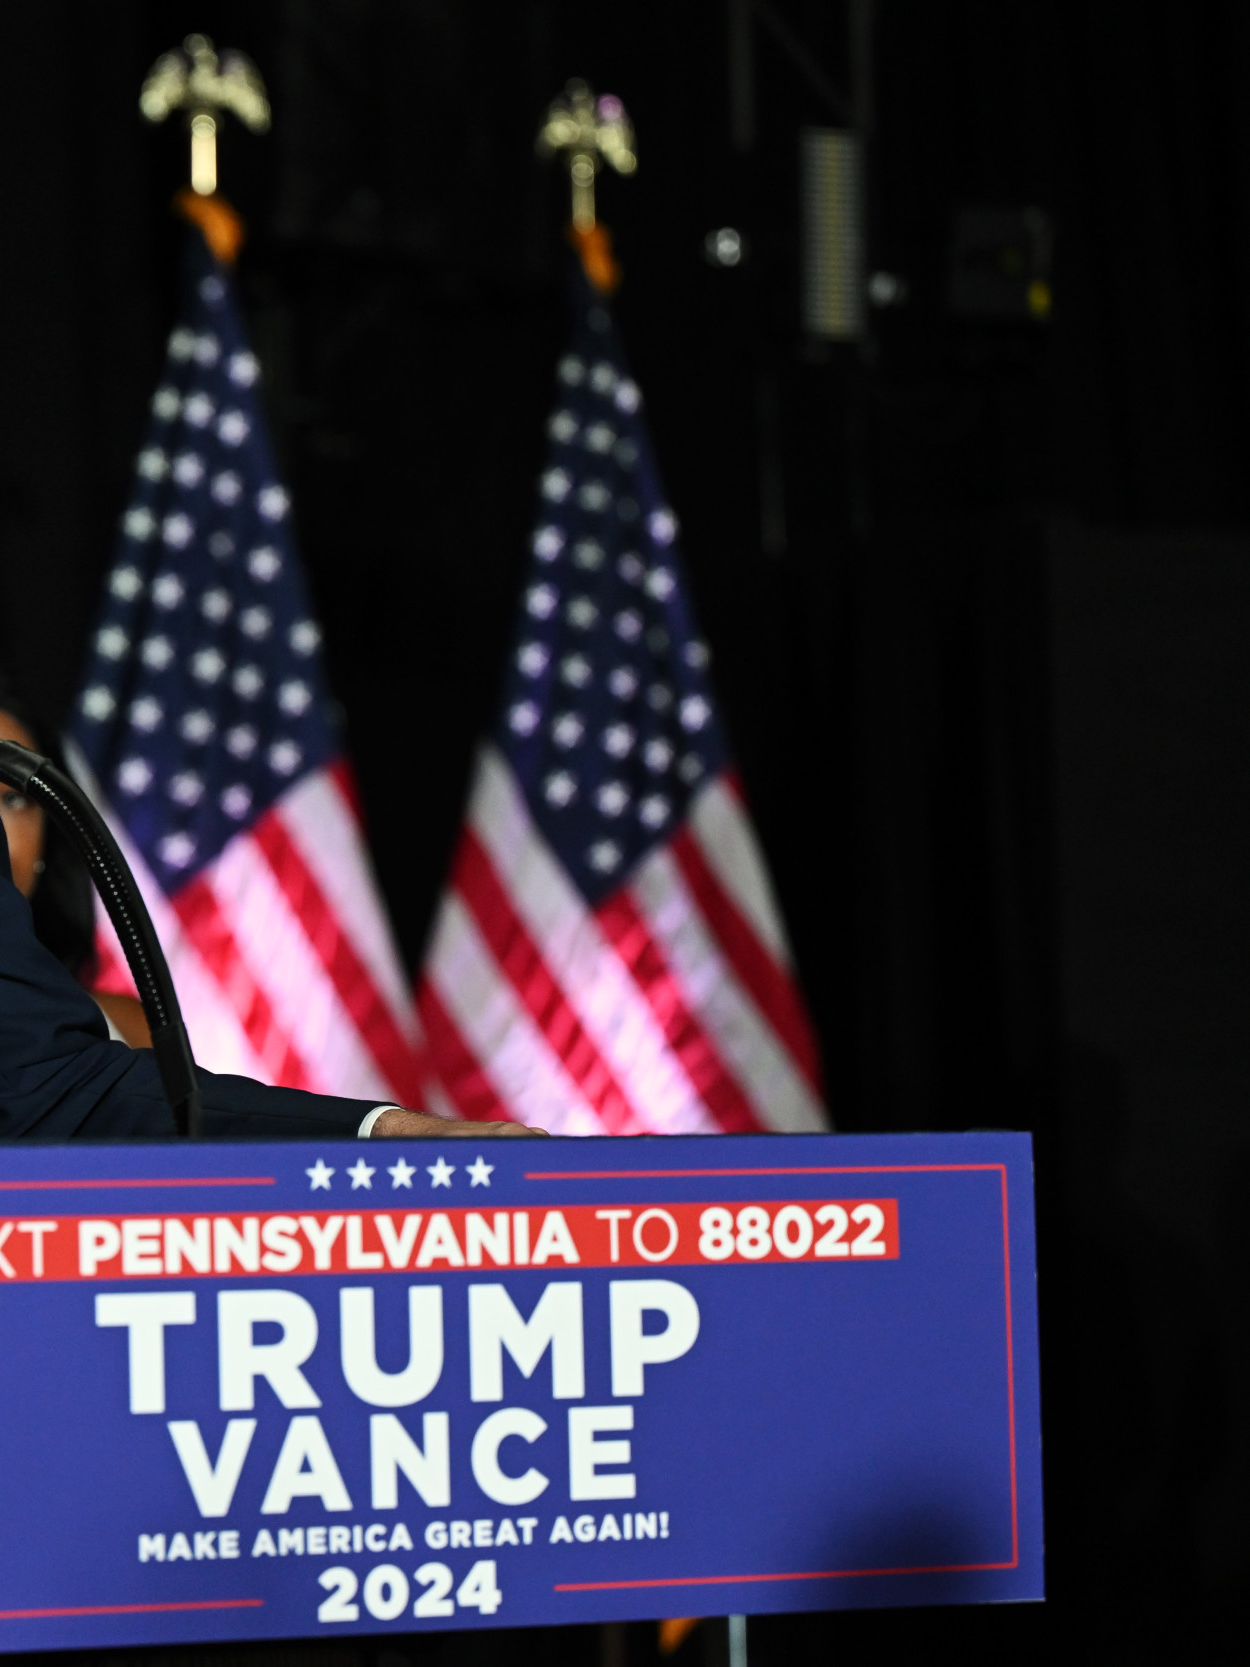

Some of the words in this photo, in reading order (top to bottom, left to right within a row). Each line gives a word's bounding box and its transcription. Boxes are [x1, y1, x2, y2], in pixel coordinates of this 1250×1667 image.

[78, 1211, 580, 1277] PENNSYLVANIA
[596, 1208, 678, 1263] TO
[699, 1204, 885, 1261] 88022
[95, 1280, 700, 1415] TRUMP
[168, 1405, 636, 1518] VANCE
[139, 1531, 239, 1563] MAKE
[252, 1523, 413, 1558] AMERICA
[425, 1518, 538, 1550] GREAT
[550, 1512, 669, 1544] AGAIN!
[318, 1560, 502, 1623] 2024
